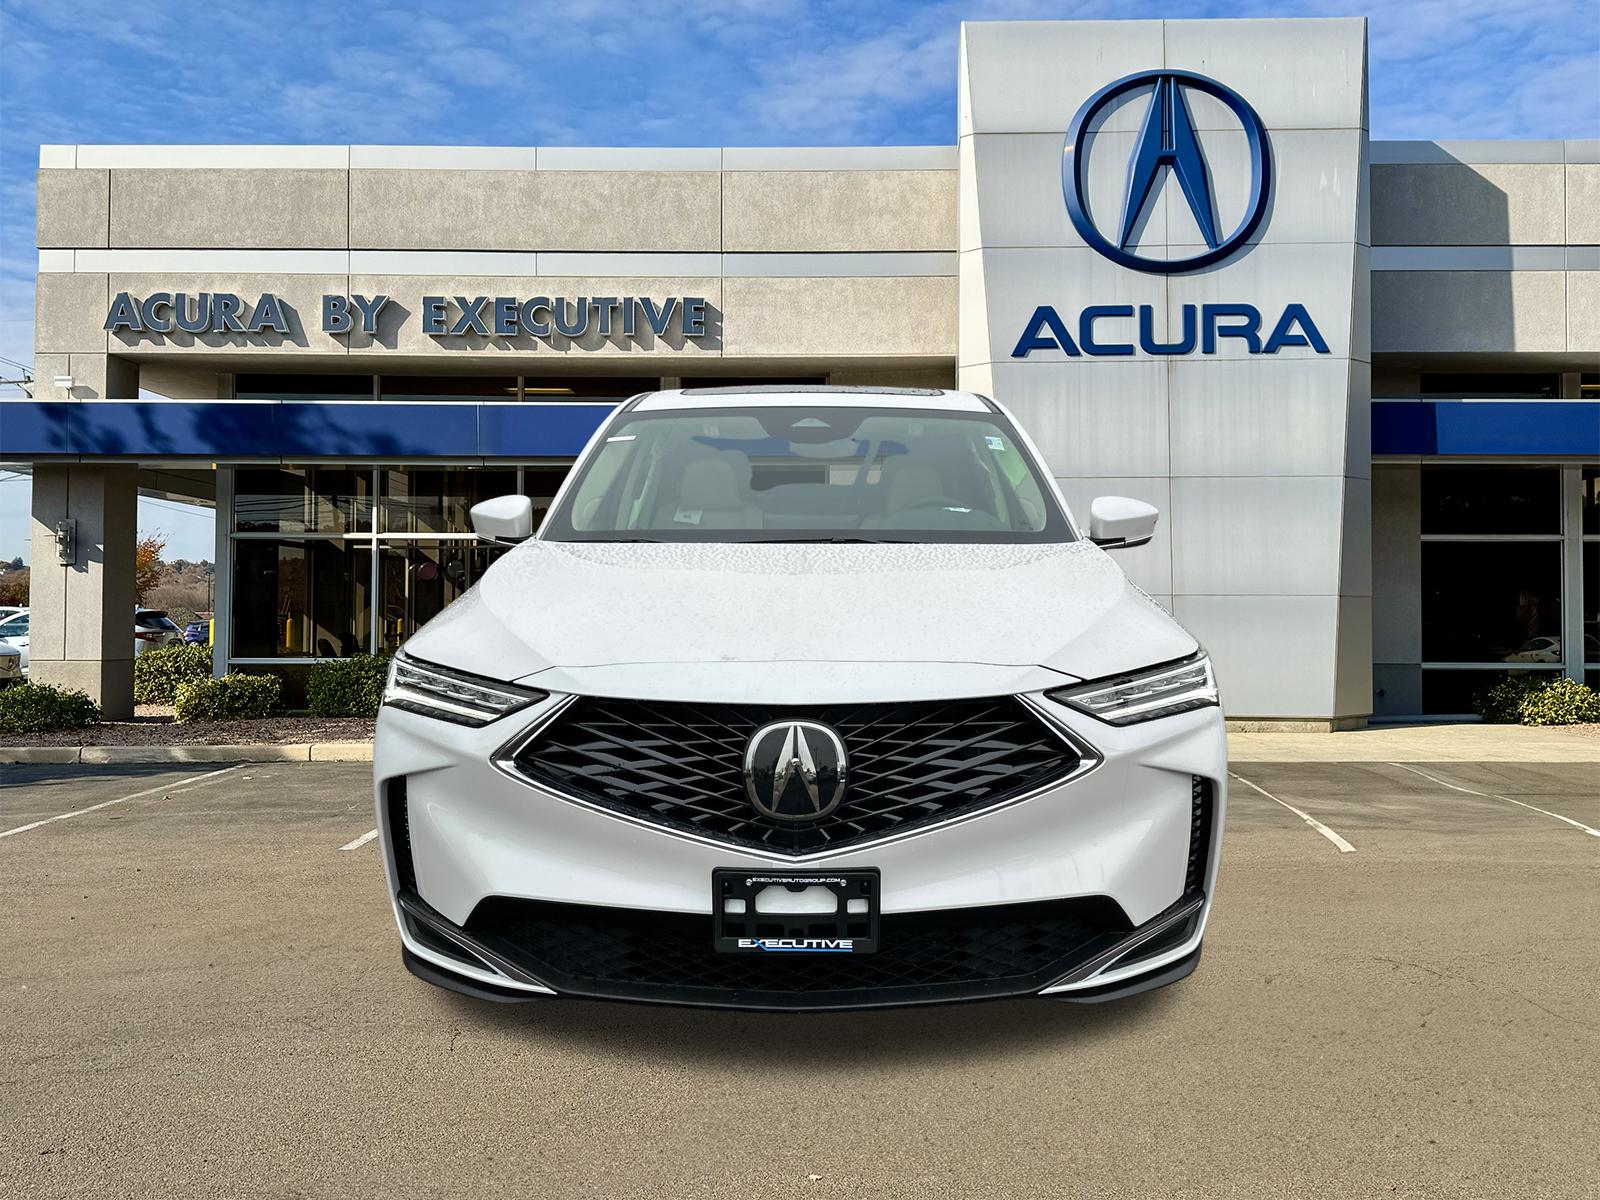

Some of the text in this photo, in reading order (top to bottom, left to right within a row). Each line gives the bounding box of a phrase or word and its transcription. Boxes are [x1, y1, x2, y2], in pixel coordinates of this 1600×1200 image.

[104, 292, 706, 338] ACURA BY EXECUTIVE
[1010, 303, 1332, 358] ACURA
[737, 938, 853, 949] EXECUTIVE
